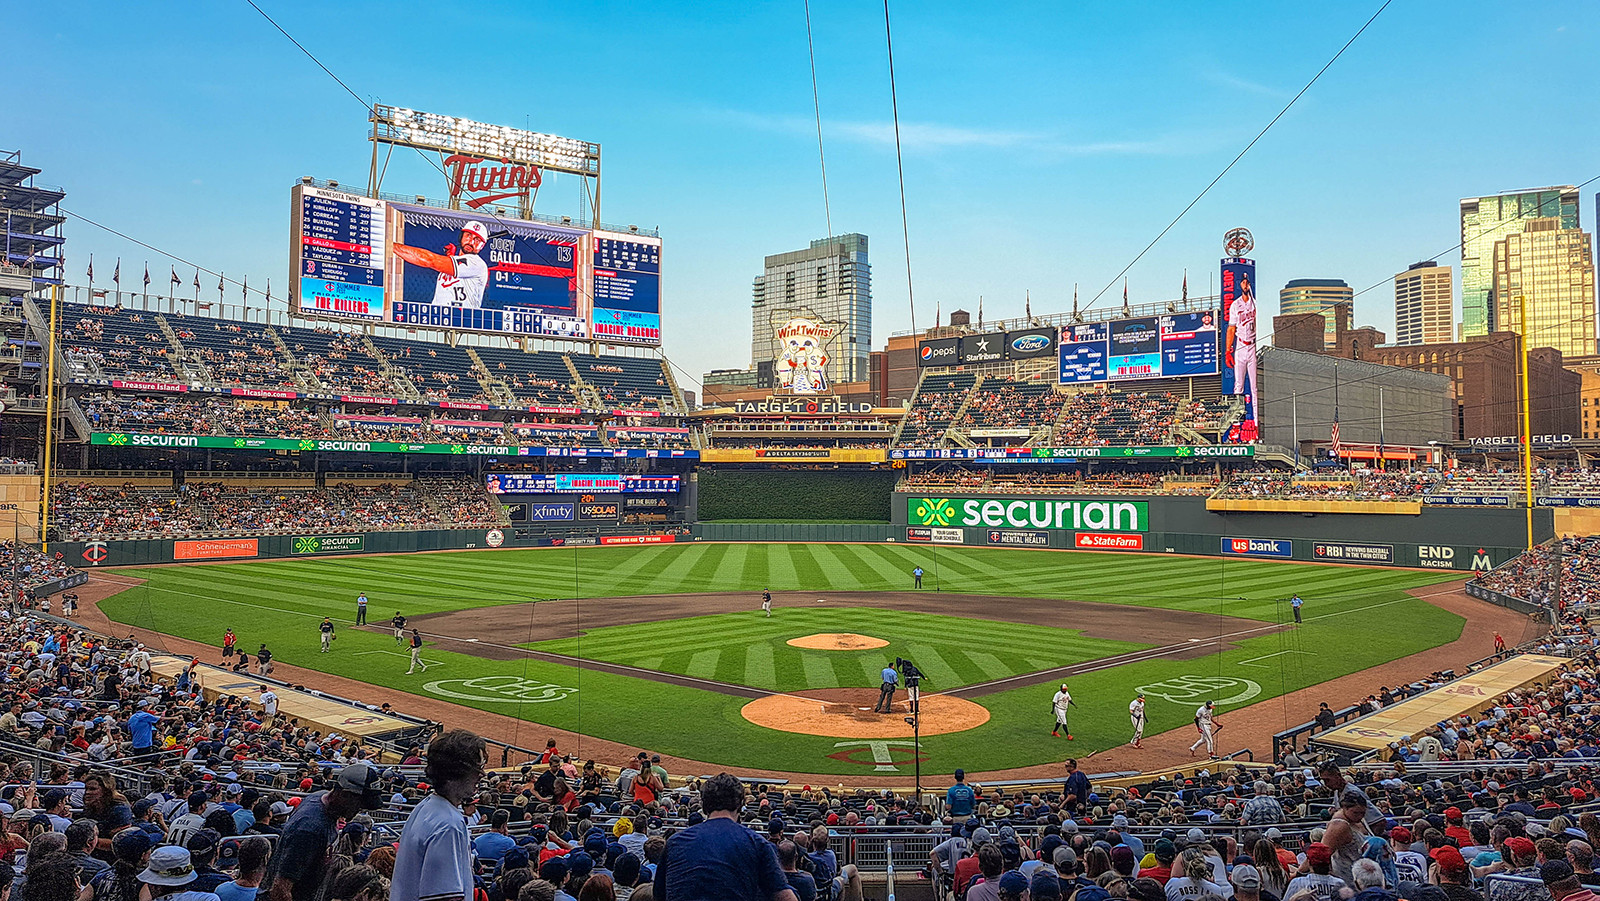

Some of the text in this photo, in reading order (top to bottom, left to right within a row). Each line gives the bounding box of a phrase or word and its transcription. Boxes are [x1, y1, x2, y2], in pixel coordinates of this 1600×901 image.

[444, 154, 542, 208] Twins
[316, 190, 360, 202] MINNESOTA TWINS
[313, 205, 338, 213] KIRILLOFF
[312, 211, 334, 219] CORREA
[313, 218, 334, 226] BUXTON
[312, 225, 333, 234] KEPLER
[312, 232, 328, 240] LEWIS
[312, 239, 330, 247] GALLO
[490, 239, 515, 252] JOEY
[312, 253, 332, 261] TAYLOR
[490, 250, 521, 264] GALLO
[557, 247, 572, 262] 13
[496, 271, 508, 282] 0-1
[1224, 270, 1234, 292] JOEY
[336, 283, 360, 291] SUMMER
[454, 287, 466, 301] 13
[315, 296, 368, 313] THE KILLERS
[411, 305, 540, 323] 1 0 1 0 2 4 0 4
[411, 315, 540, 333] 0 2 1 0 3 5 1 1
[547, 321, 580, 331] 0 0 0
[595, 323, 659, 338] IMAGINE DRAGONS
[778, 324, 833, 339] Win! Twins!
[1018, 336, 1047, 350] Ford
[933, 346, 956, 357] pepsi
[966, 352, 1000, 361] StarTribune
[810, 356, 817, 365] S
[1169, 353, 1176, 362] 11
[1118, 365, 1151, 375] THE KILLERS
[121, 381, 180, 392] Treasure Island
[374, 396, 392, 404] Island
[735, 403, 872, 412] TARGET FIELD
[448, 426, 469, 434] Home
[132, 434, 198, 446] securian
[1469, 435, 1571, 445] TARGET FIELD
[318, 440, 370, 451] securian
[466, 444, 509, 455] securian
[1053, 447, 1100, 457] securian
[1194, 447, 1248, 456] securian
[1424, 496, 1447, 504] Corona
[1452, 496, 1476, 504] Corona
[1482, 496, 1507, 505] Corona
[1578, 498, 1600, 506] Coron
[534, 506, 572, 519] xfinity
[962, 500, 1138, 530] securian
[321, 536, 360, 546] securian
[1022, 536, 1046, 544] HEALTH
[196, 542, 253, 551] Schneiderman's
[1233, 540, 1279, 552] us bank
[1326, 547, 1342, 557] RBI
[1419, 546, 1454, 558] END
[1471, 555, 1492, 570] M
[462, 676, 579, 699] CHS
[1135, 675, 1238, 698] CHS
[1428, 745, 1435, 754] 2
[168, 829, 188, 845] 41
[1179, 886, 1198, 896] BOSS
